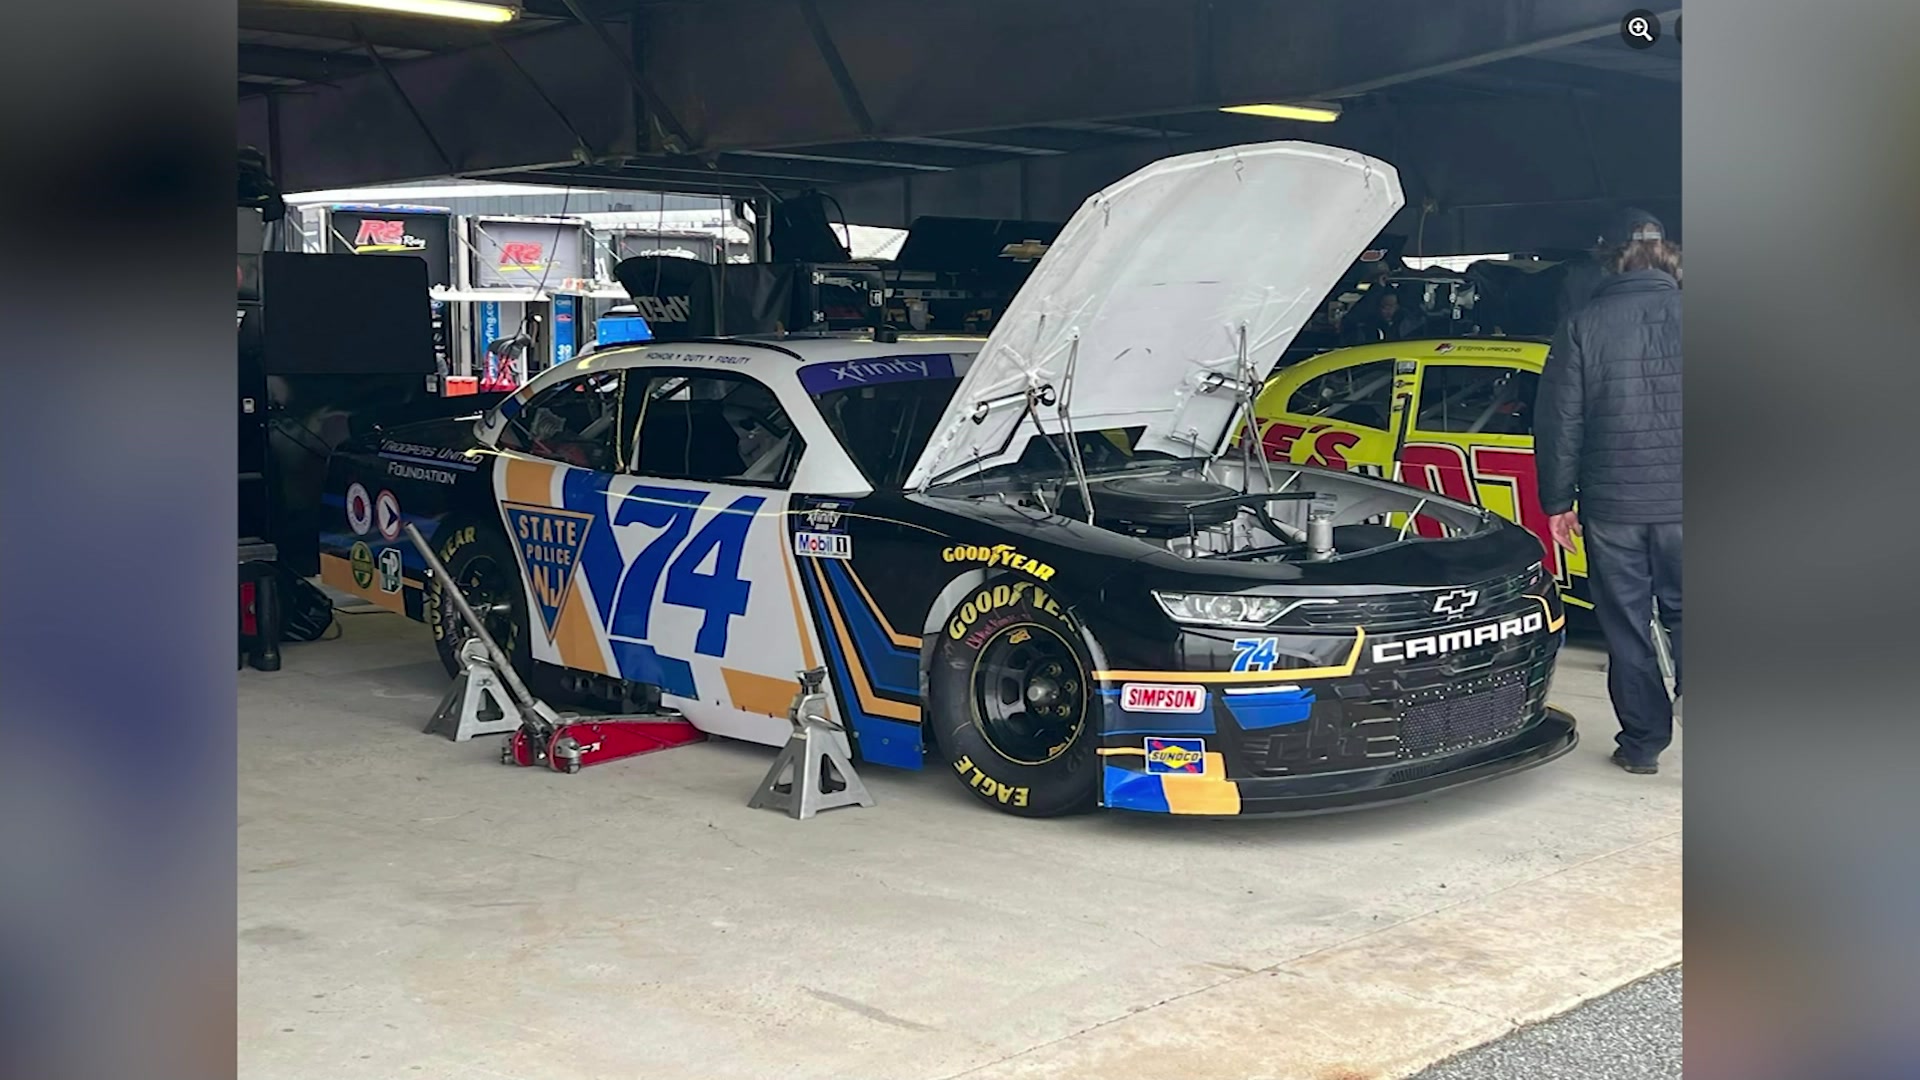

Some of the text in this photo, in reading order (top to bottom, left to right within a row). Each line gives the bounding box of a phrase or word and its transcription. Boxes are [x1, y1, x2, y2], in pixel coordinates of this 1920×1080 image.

[683, 353, 706, 362] DUTY
[714, 355, 751, 364] FIDELITY
[829, 359, 929, 382] xfinity
[388, 461, 457, 485] FOUNDATION
[519, 514, 577, 547] STATE
[799, 534, 833, 552] Mobil
[526, 545, 571, 565] POLICE
[611, 485, 767, 658] 74
[942, 543, 1056, 582] GOODYEAR
[532, 565, 565, 608] NJ
[949, 581, 1081, 640] GOODYE
[1371, 611, 1543, 664] CAMARO
[1231, 637, 1279, 673] 74
[1128, 687, 1197, 709] SIMPSON
[1150, 750, 1200, 763] SUNOCO
[952, 755, 1030, 807] EAGLE
